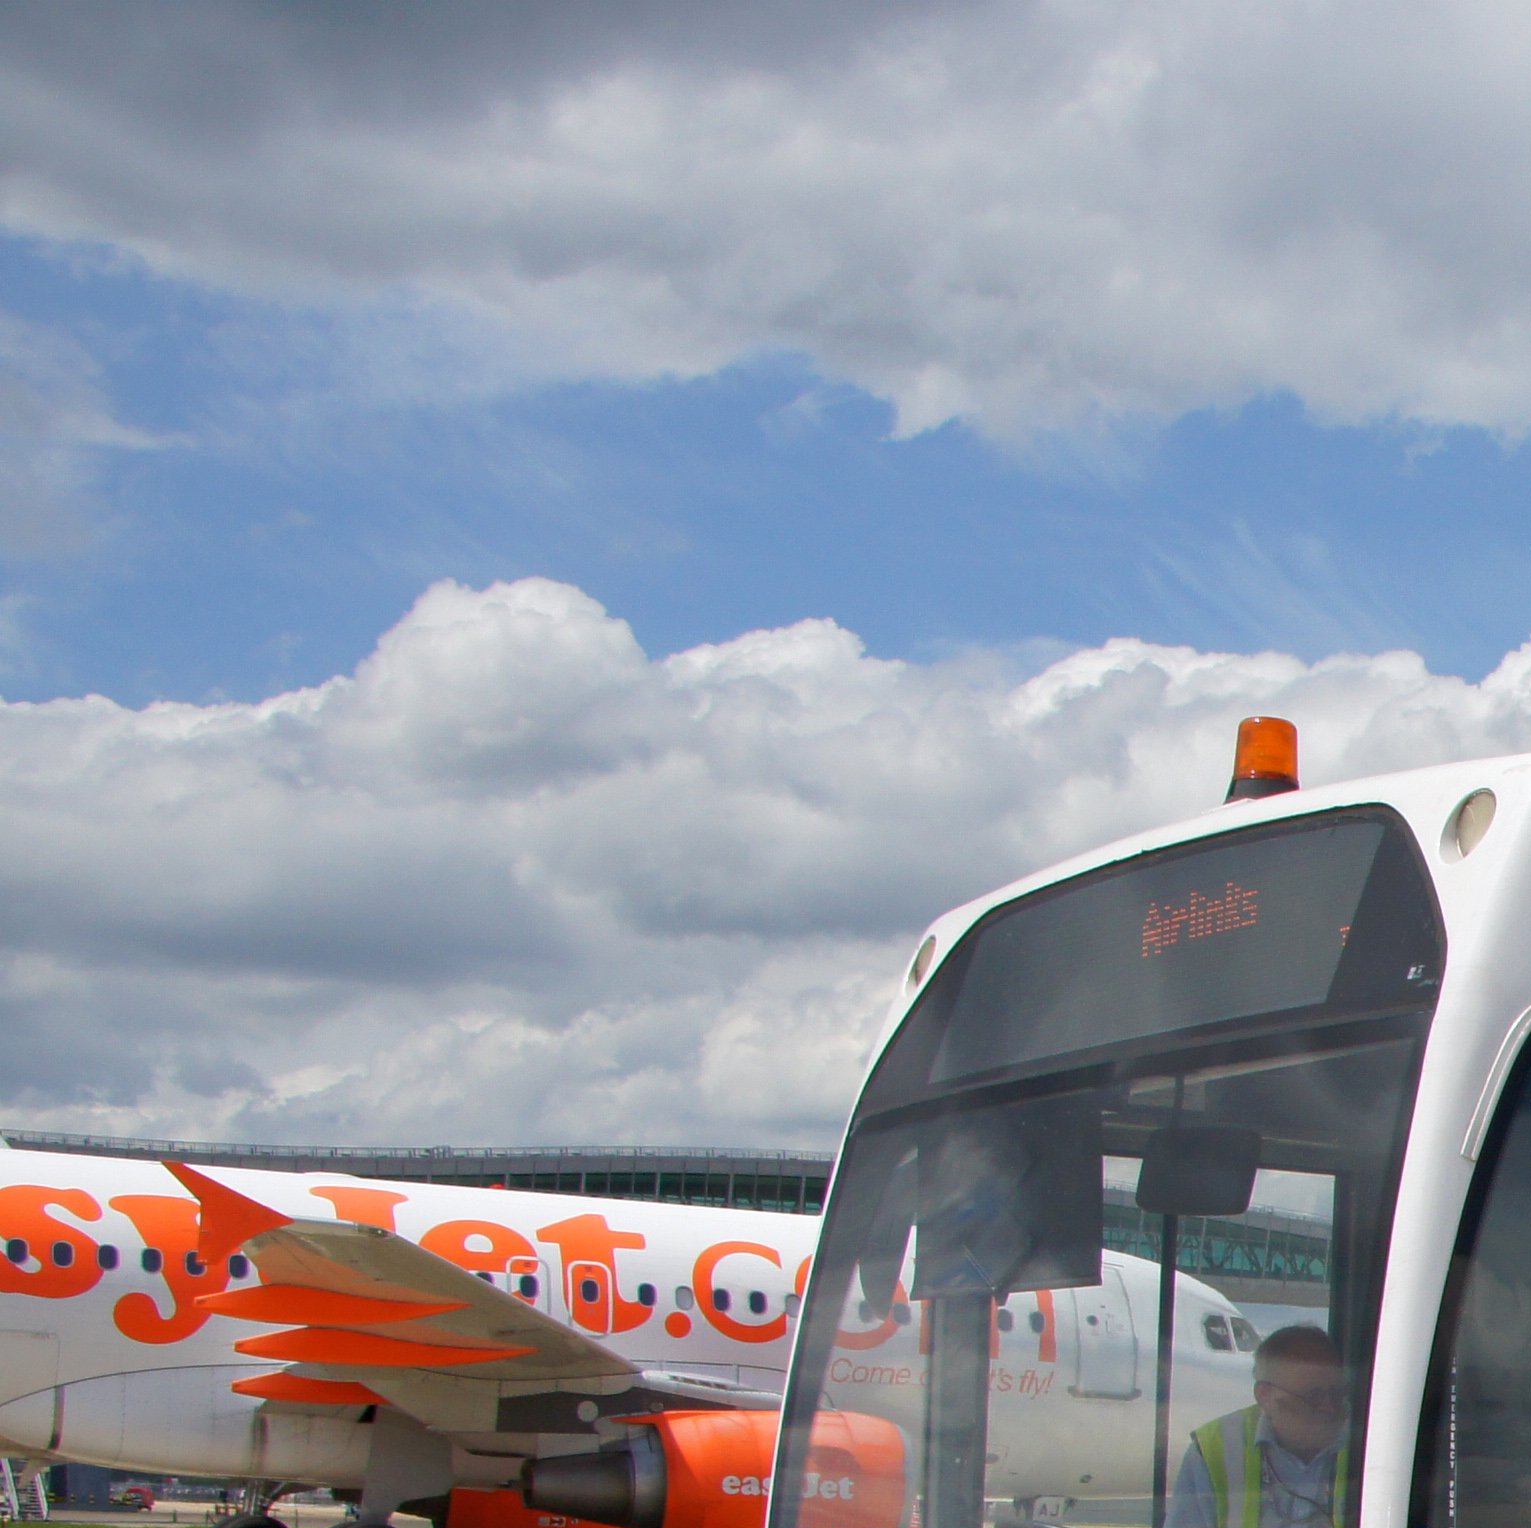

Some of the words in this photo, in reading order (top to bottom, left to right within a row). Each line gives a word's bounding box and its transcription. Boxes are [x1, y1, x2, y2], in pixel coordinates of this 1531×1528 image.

[830, 1358, 911, 1386] Come
[1449, 1384, 1457, 1470] EMERGENCY
[721, 1472, 855, 1500] easJet
